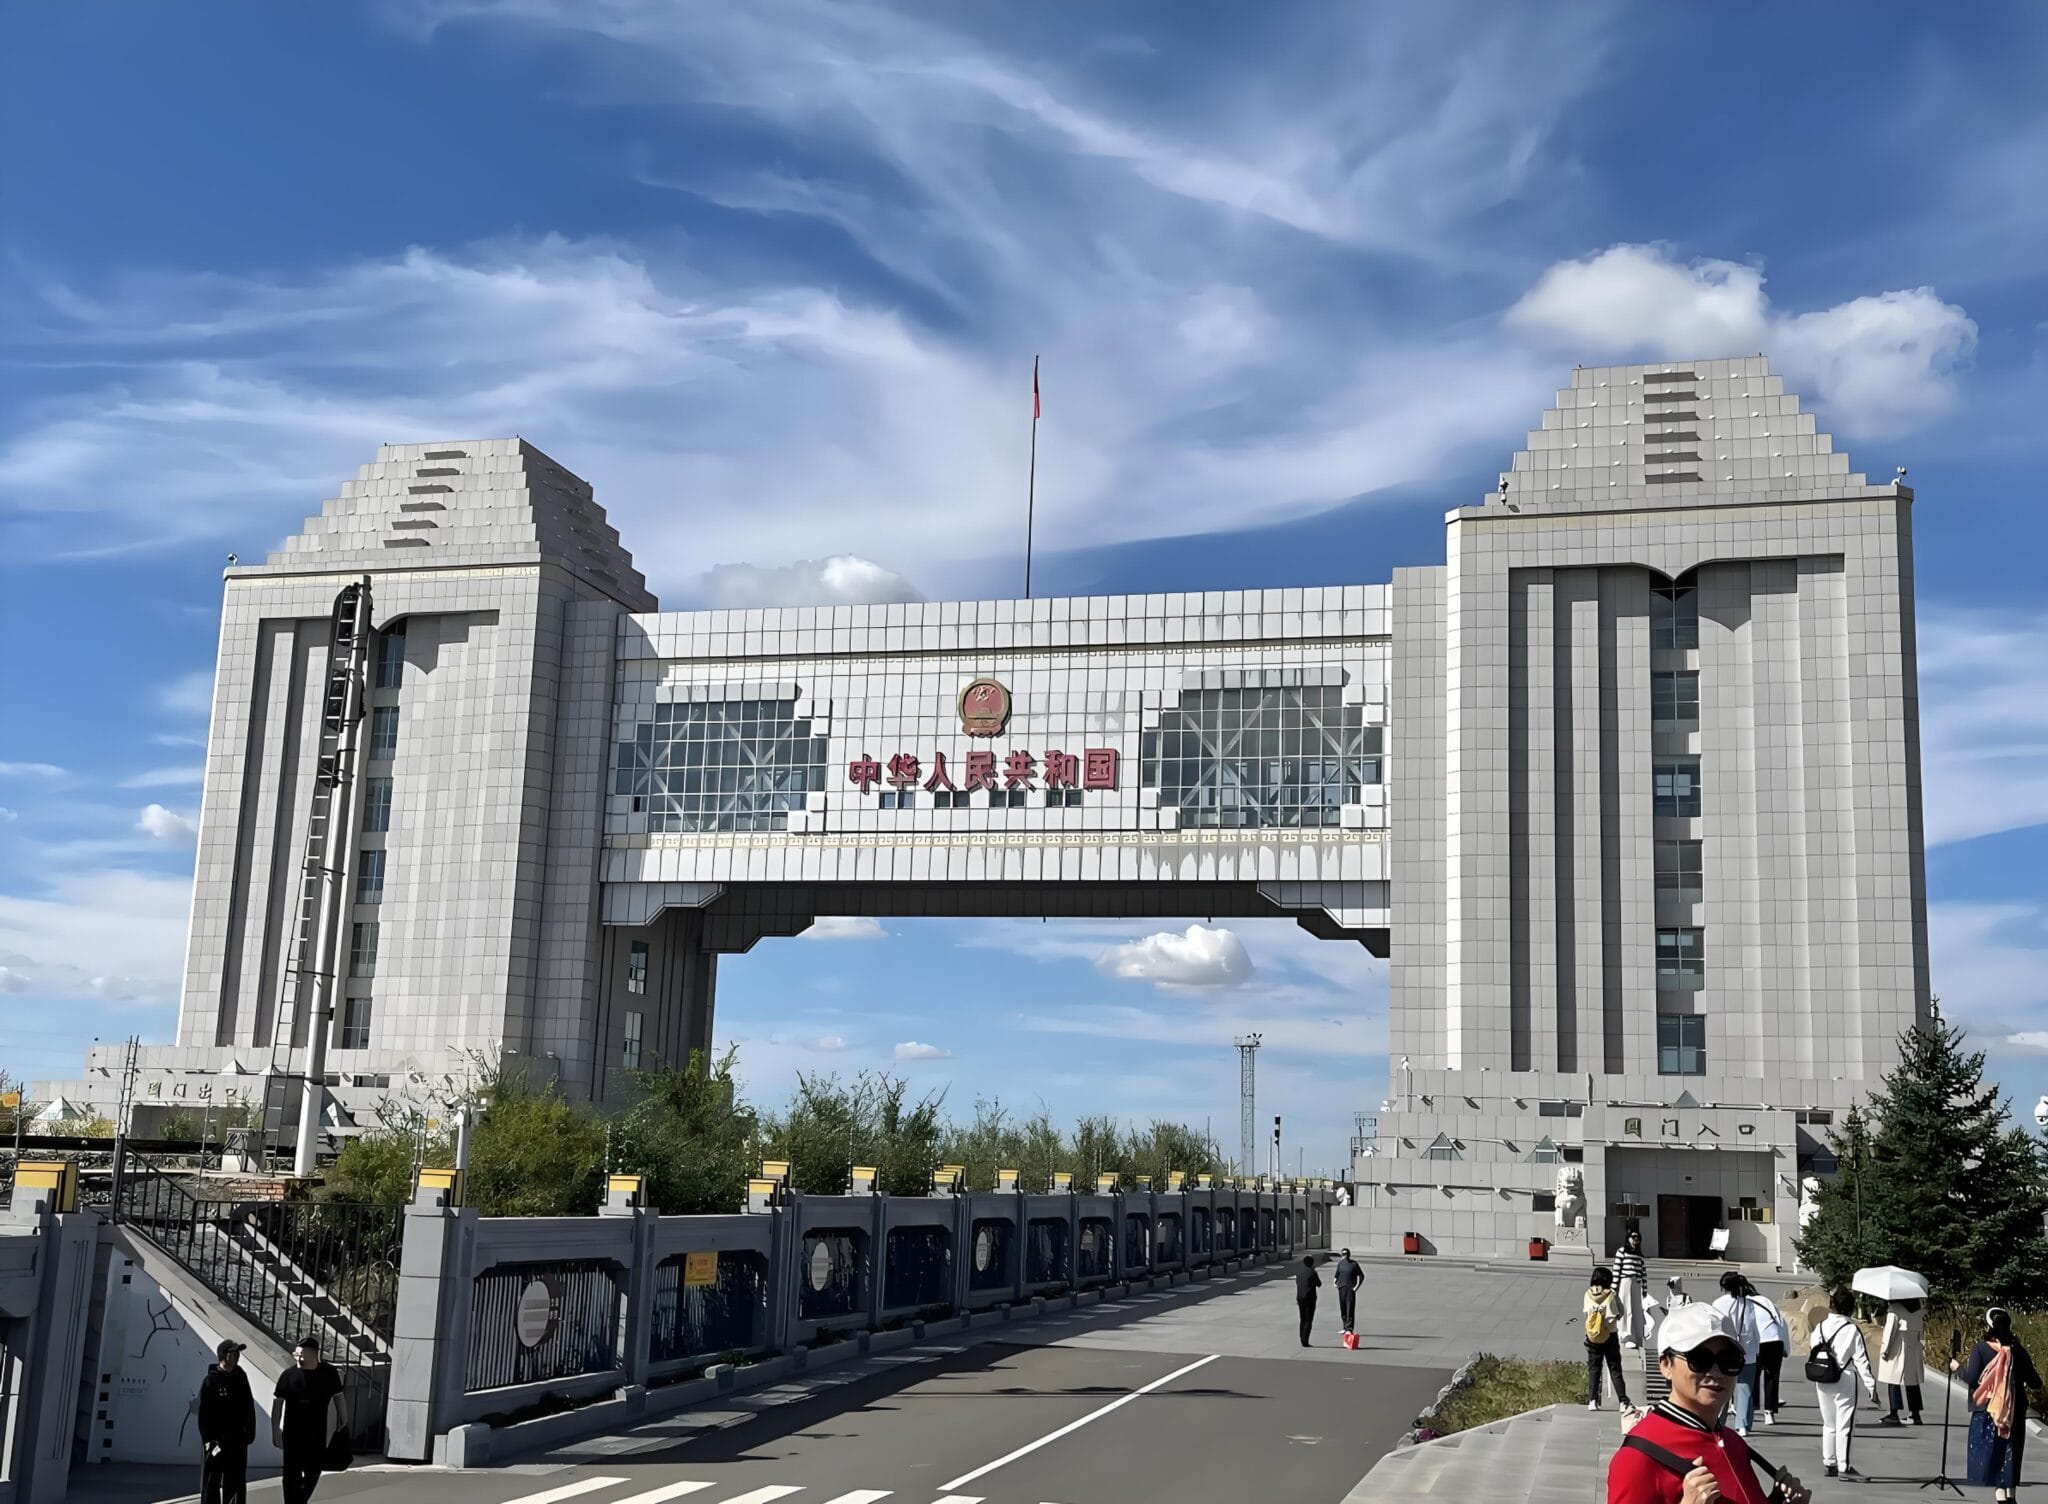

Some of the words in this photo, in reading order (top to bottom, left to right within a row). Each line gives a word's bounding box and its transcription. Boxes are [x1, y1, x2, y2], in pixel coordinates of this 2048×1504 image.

[849, 748, 1119, 795] 中华人民共和国
